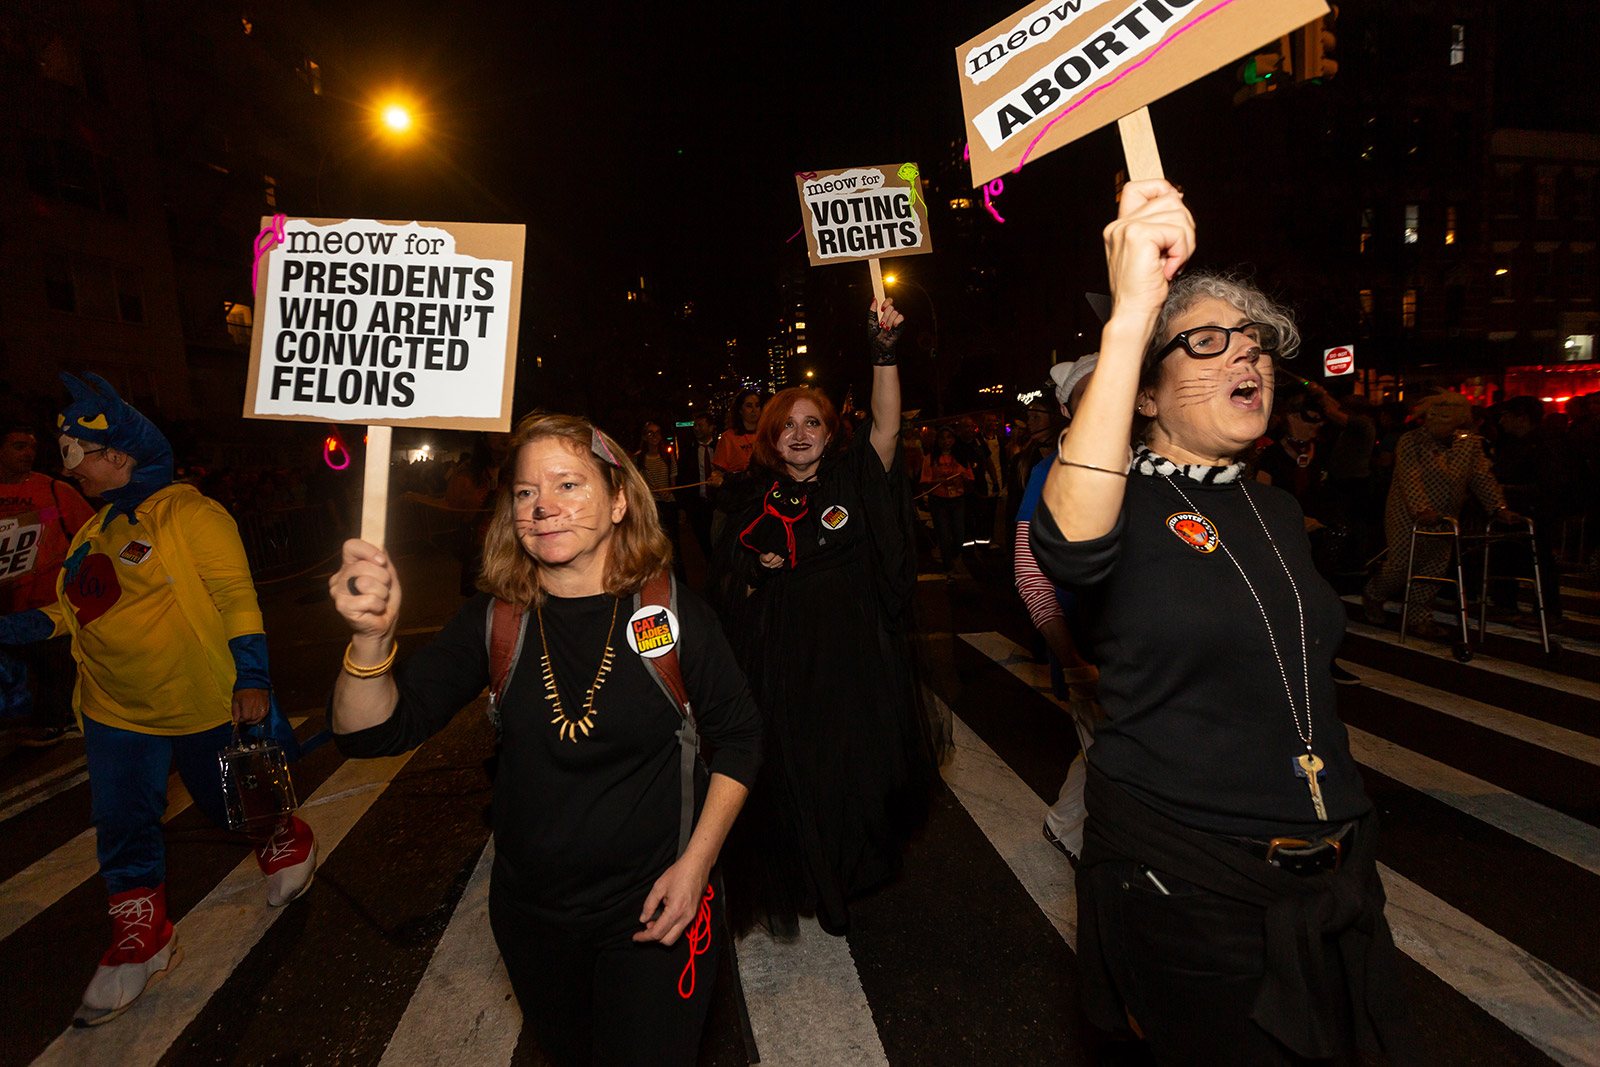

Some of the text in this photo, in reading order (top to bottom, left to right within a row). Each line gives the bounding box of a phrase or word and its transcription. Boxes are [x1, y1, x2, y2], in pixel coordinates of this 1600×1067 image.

[969, 0, 1082, 75] meow
[806, 174, 880, 196] meow for
[811, 194, 912, 226] VOTING
[286, 230, 445, 255] meow for
[818, 221, 918, 255] RIGHTS
[281, 260, 494, 300] PRESIDENTS
[279, 296, 358, 332] WHO
[275, 330, 470, 372] CONVICTED
[269, 365, 416, 408] FELONS
[633, 616, 656, 633] CAT
[635, 624, 670, 643] LADIES
[637, 632, 673, 652] UNITE!
